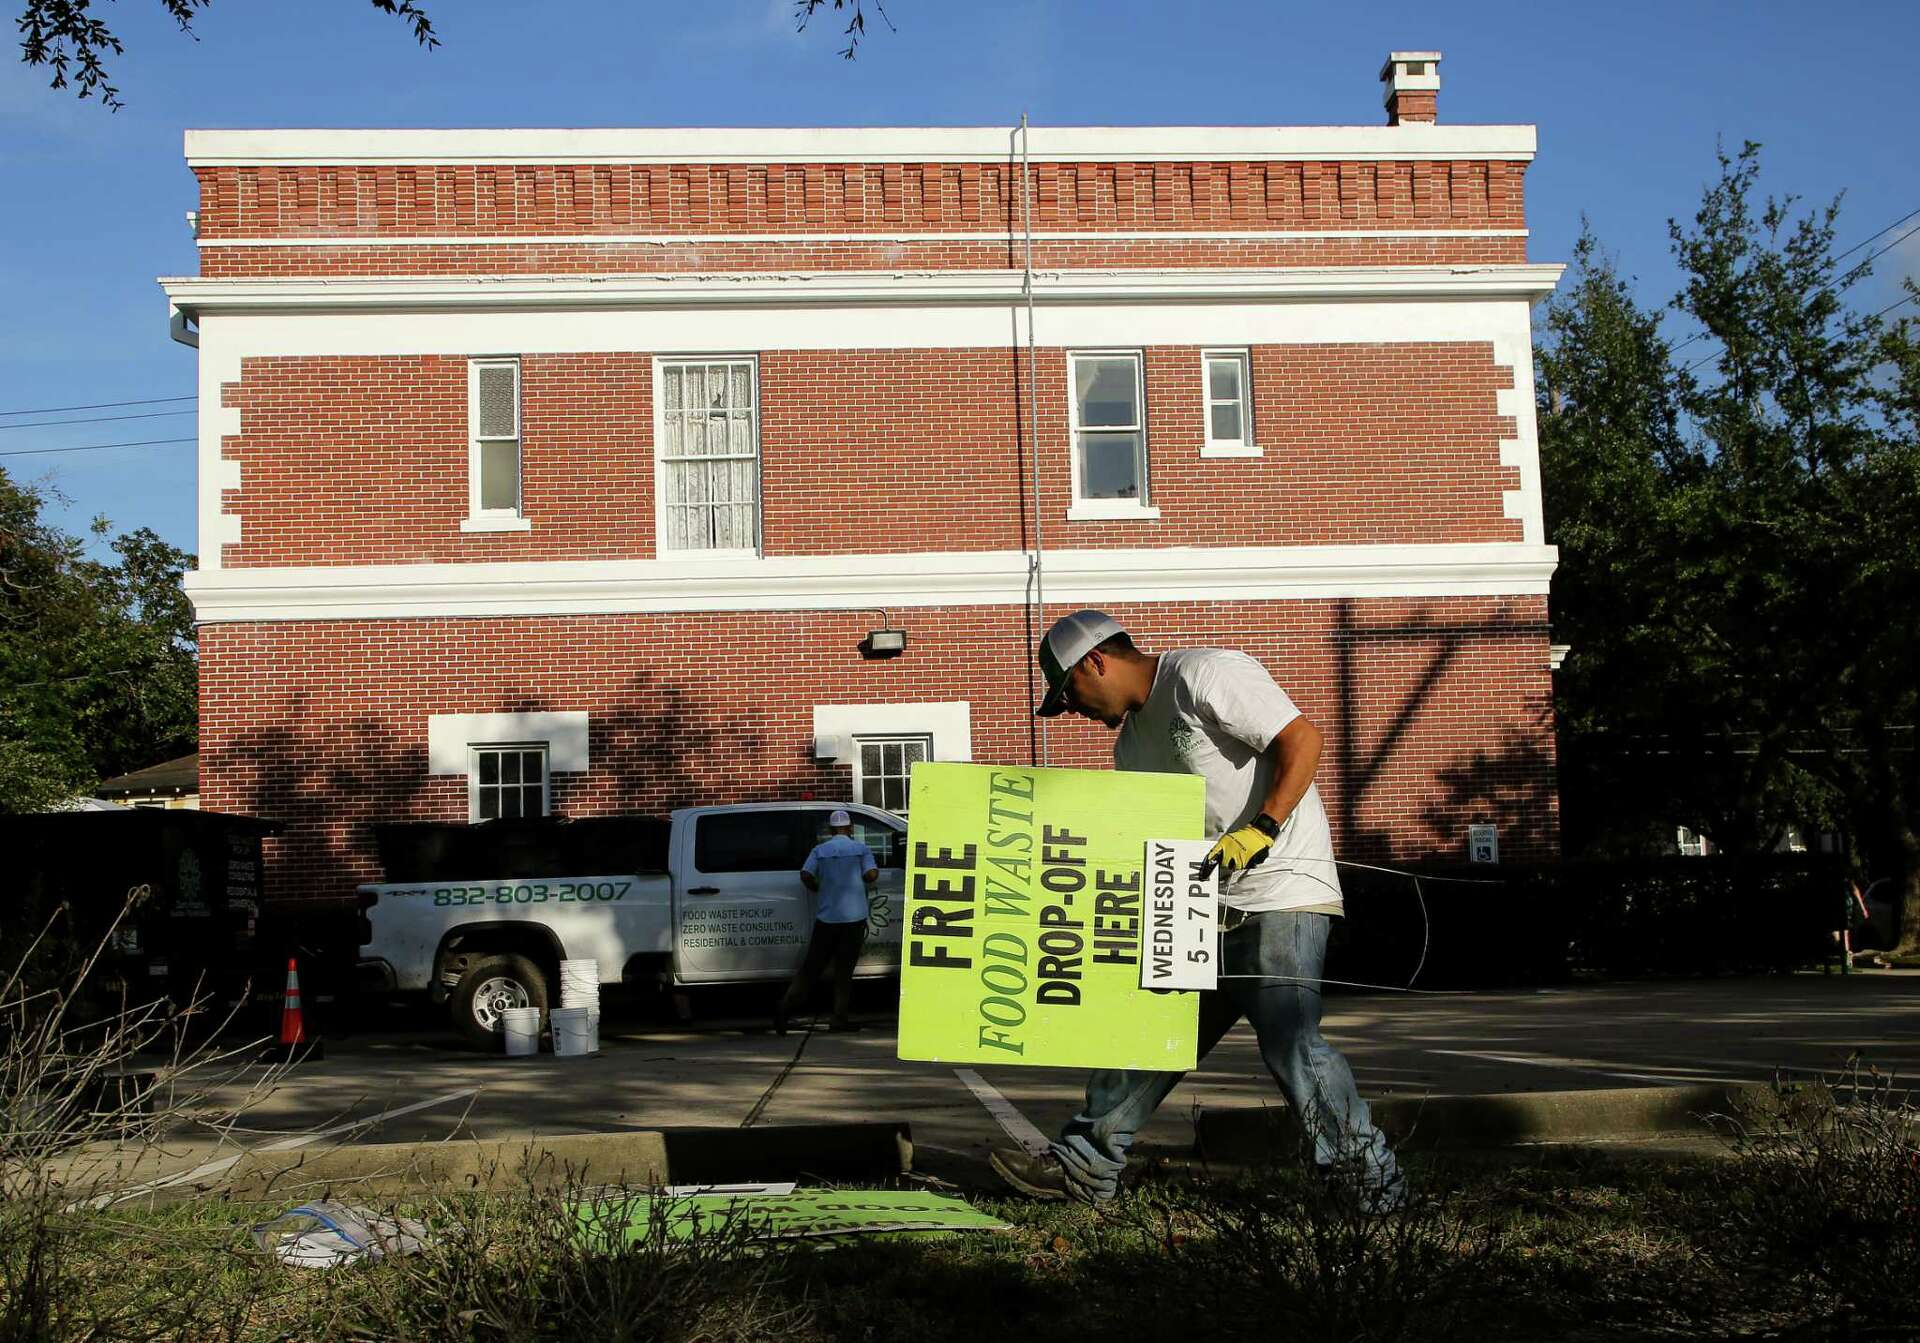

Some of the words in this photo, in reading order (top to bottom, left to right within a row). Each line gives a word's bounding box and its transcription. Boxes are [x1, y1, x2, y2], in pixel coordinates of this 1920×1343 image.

[434, 882, 632, 906] 832-803-2007
[984, 772, 1035, 918] WASTE
[682, 910, 706, 921] FOOD
[708, 909, 738, 920] WASTE
[740, 908, 760, 919] PICK
[761, 908, 774, 918] UP
[682, 924, 706, 934] ZERO
[708, 923, 737, 934] WASTE
[739, 922, 794, 933] CONSULTING
[683, 937, 738, 948] RESIDENTIAL
[910, 841, 977, 969] FREE
[1036, 824, 1088, 1006] DROP-OFF
[1093, 869, 1141, 965] HERE
[1153, 843, 1174, 978] WEDNESDAY
[979, 932, 1028, 1056] FOOD
